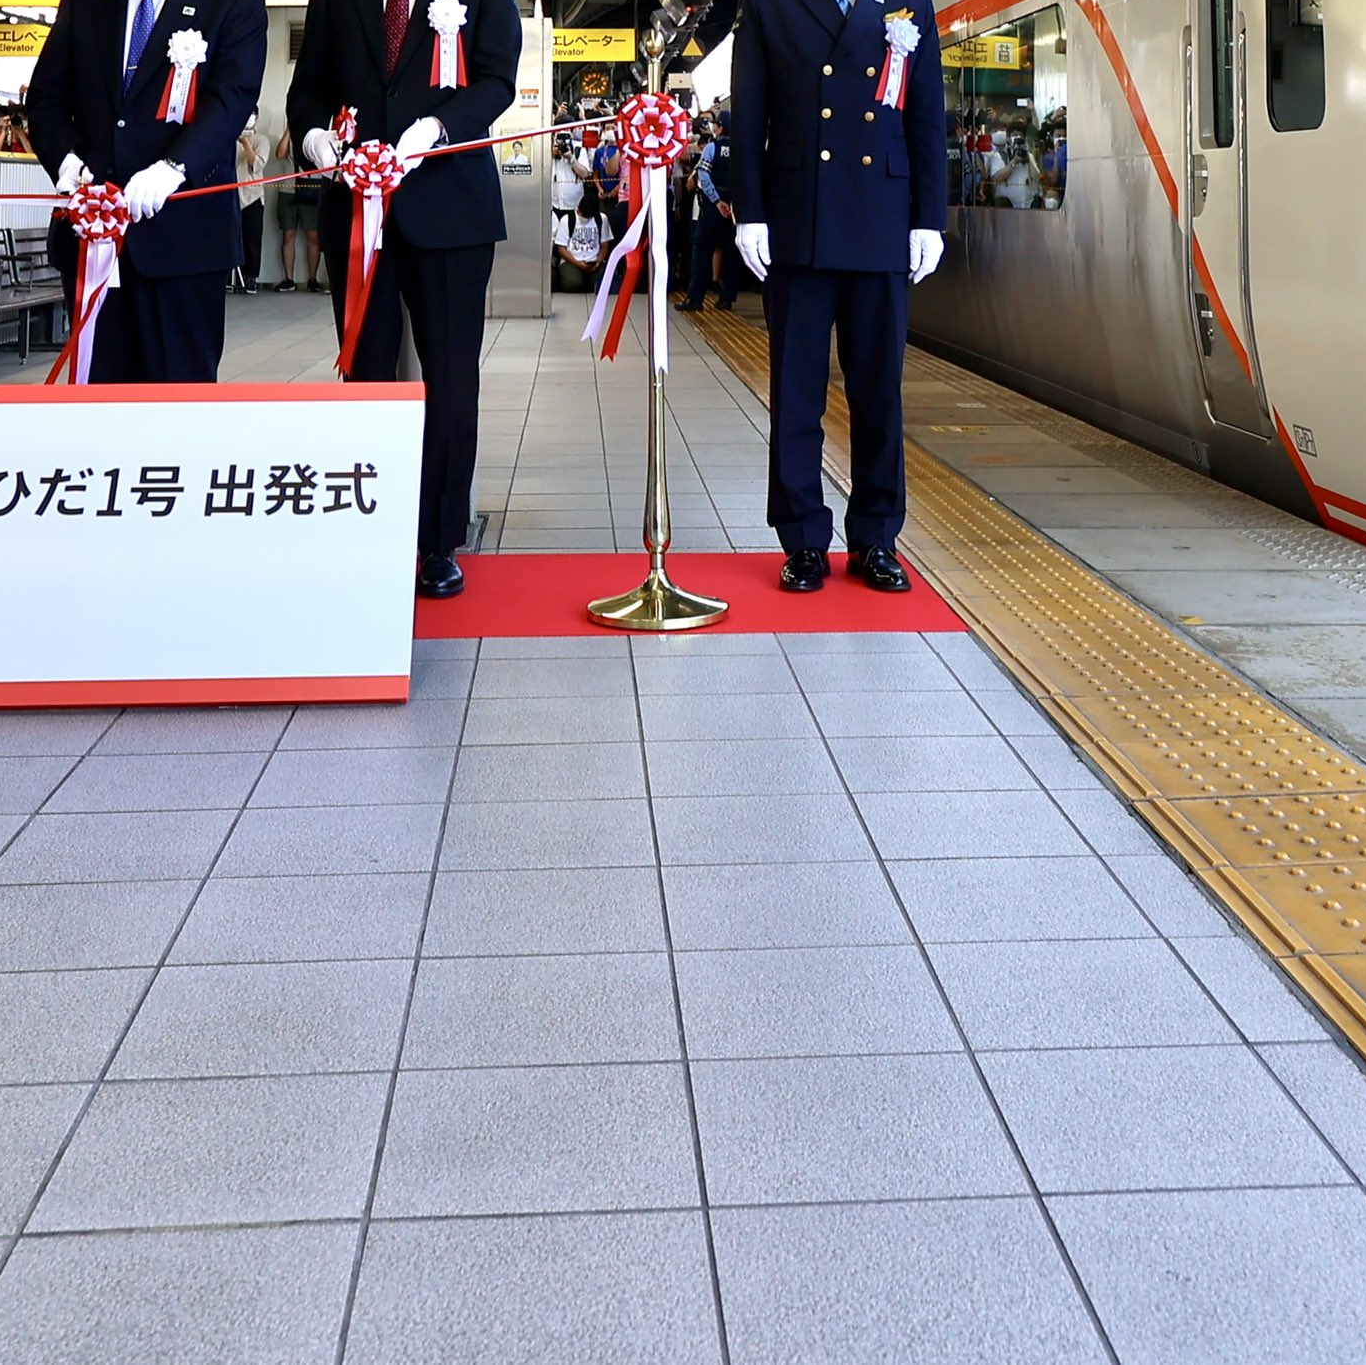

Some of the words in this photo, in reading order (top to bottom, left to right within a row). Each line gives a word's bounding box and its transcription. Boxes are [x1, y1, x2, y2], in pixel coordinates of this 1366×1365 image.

[553, 35, 626, 46] エレベーター
[202, 462, 379, 519] 出発式
